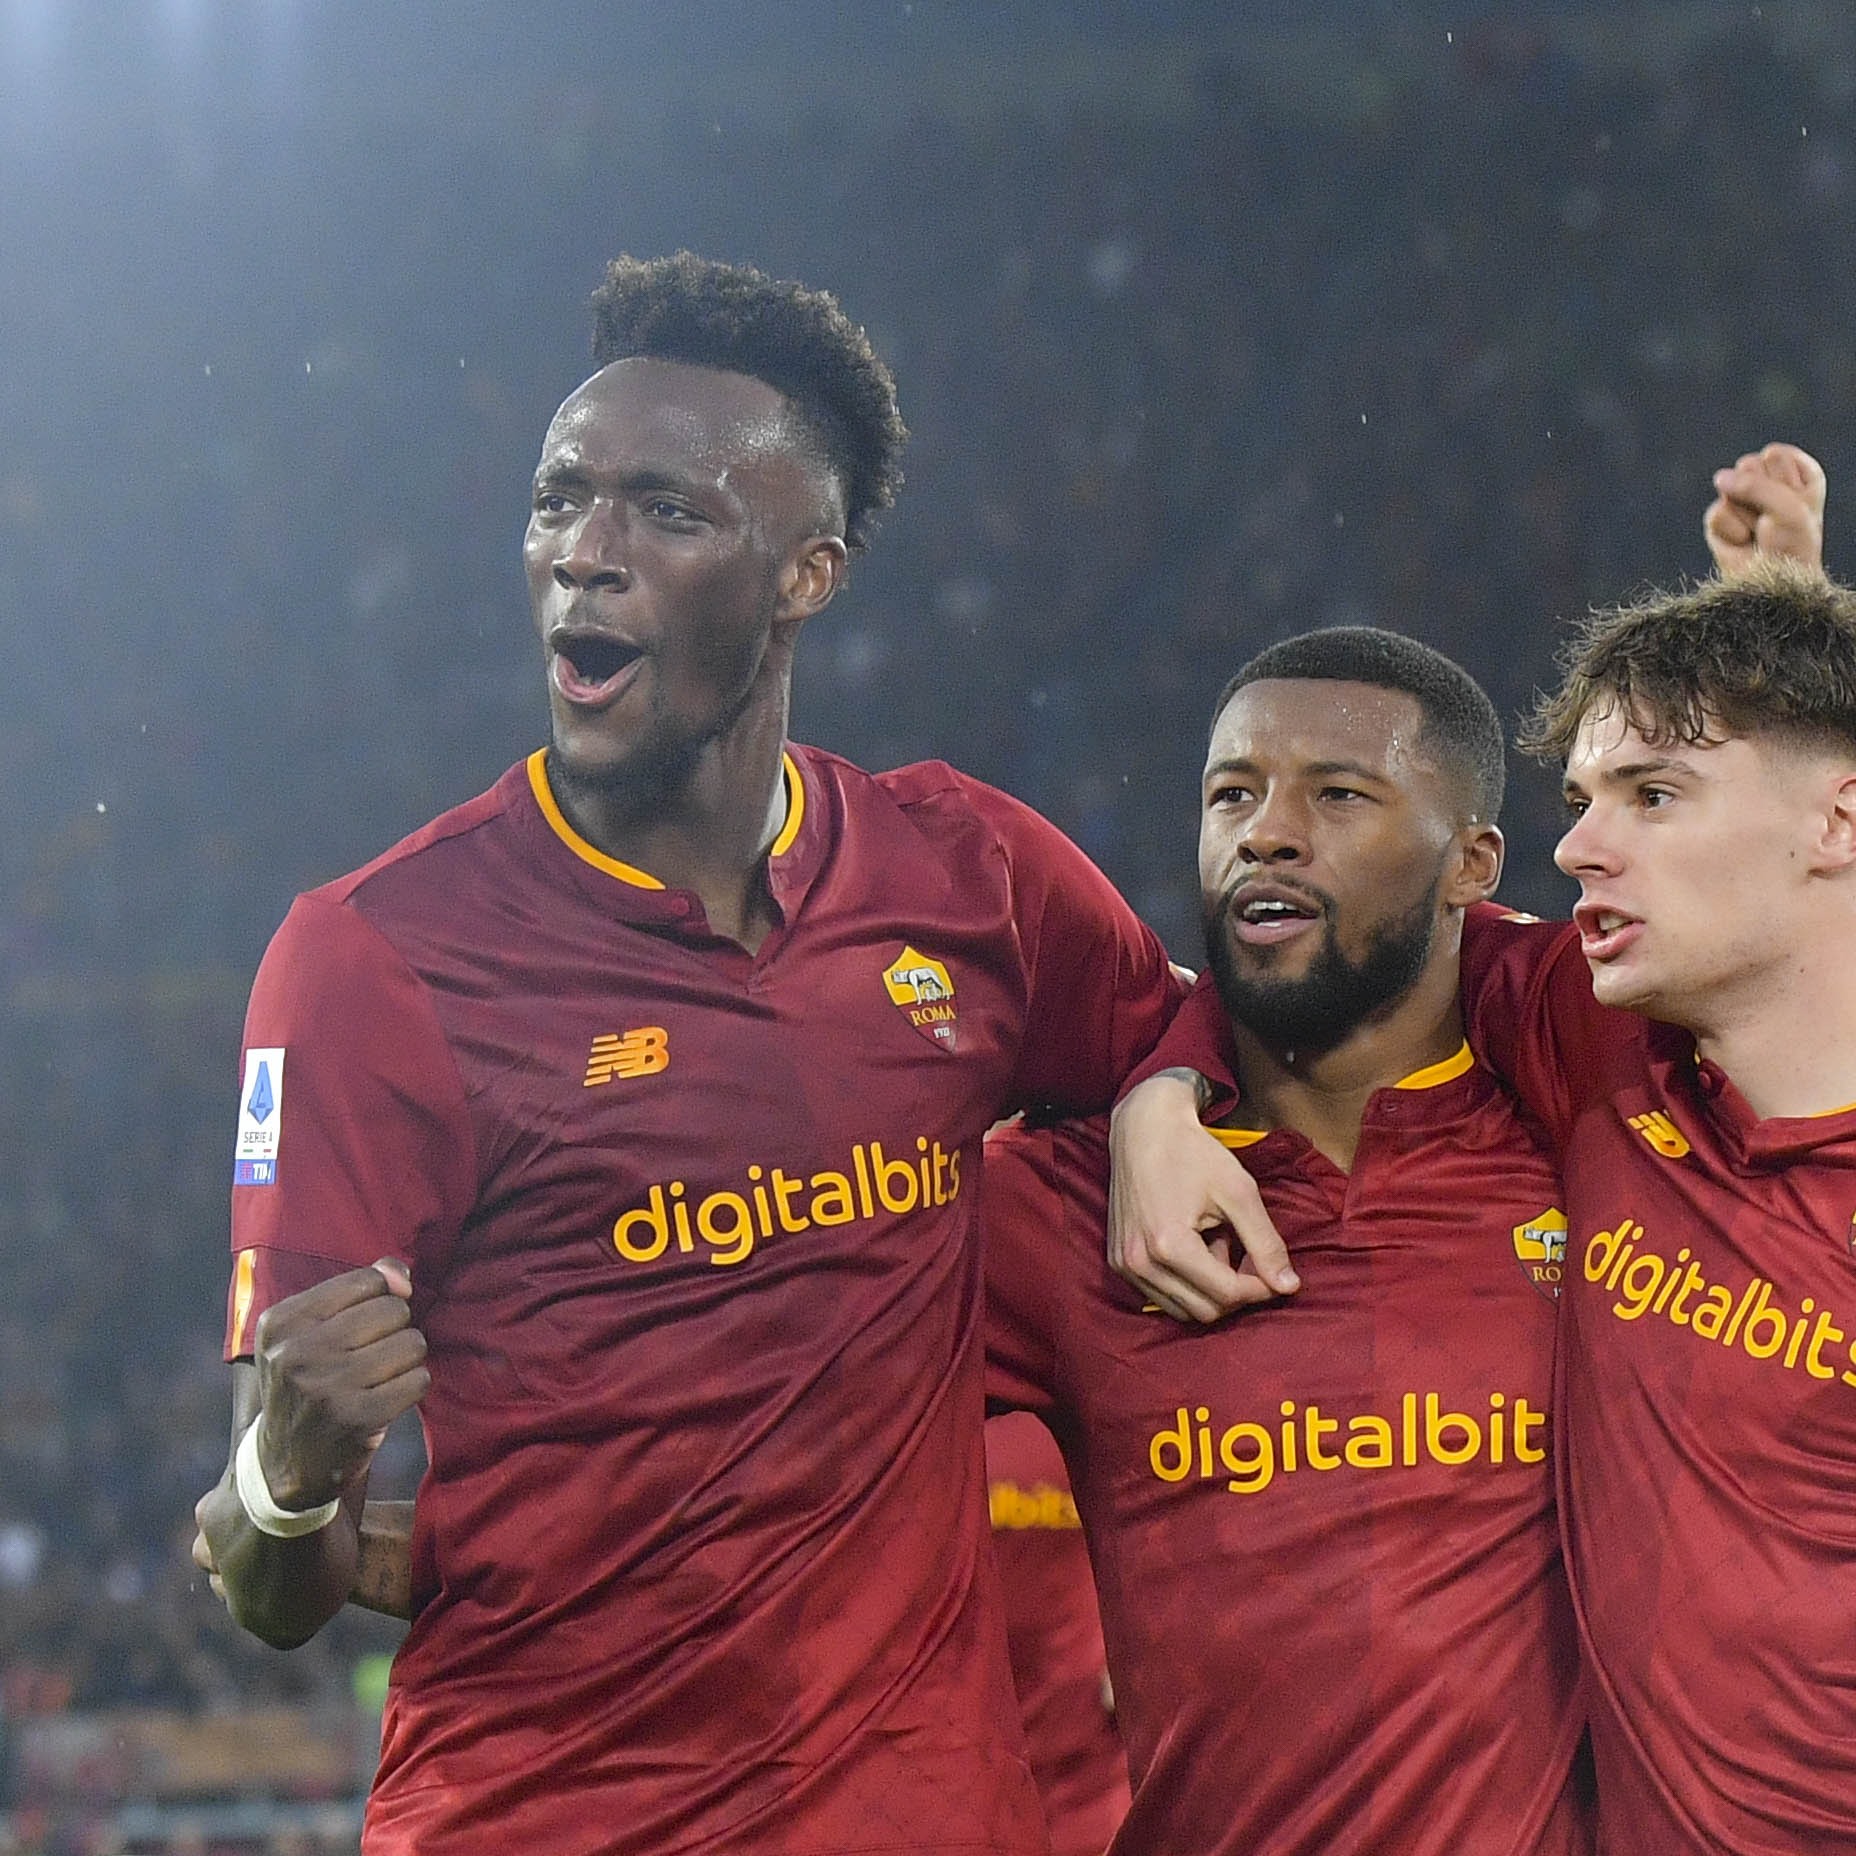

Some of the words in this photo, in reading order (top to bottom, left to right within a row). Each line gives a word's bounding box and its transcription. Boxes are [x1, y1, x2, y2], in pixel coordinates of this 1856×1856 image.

[909, 1004, 956, 1026] ROMA
[613, 1136, 961, 1266] digitalbits
[1532, 1265, 1562, 1283] RO
[1149, 1391, 1546, 1496] digitalbit
